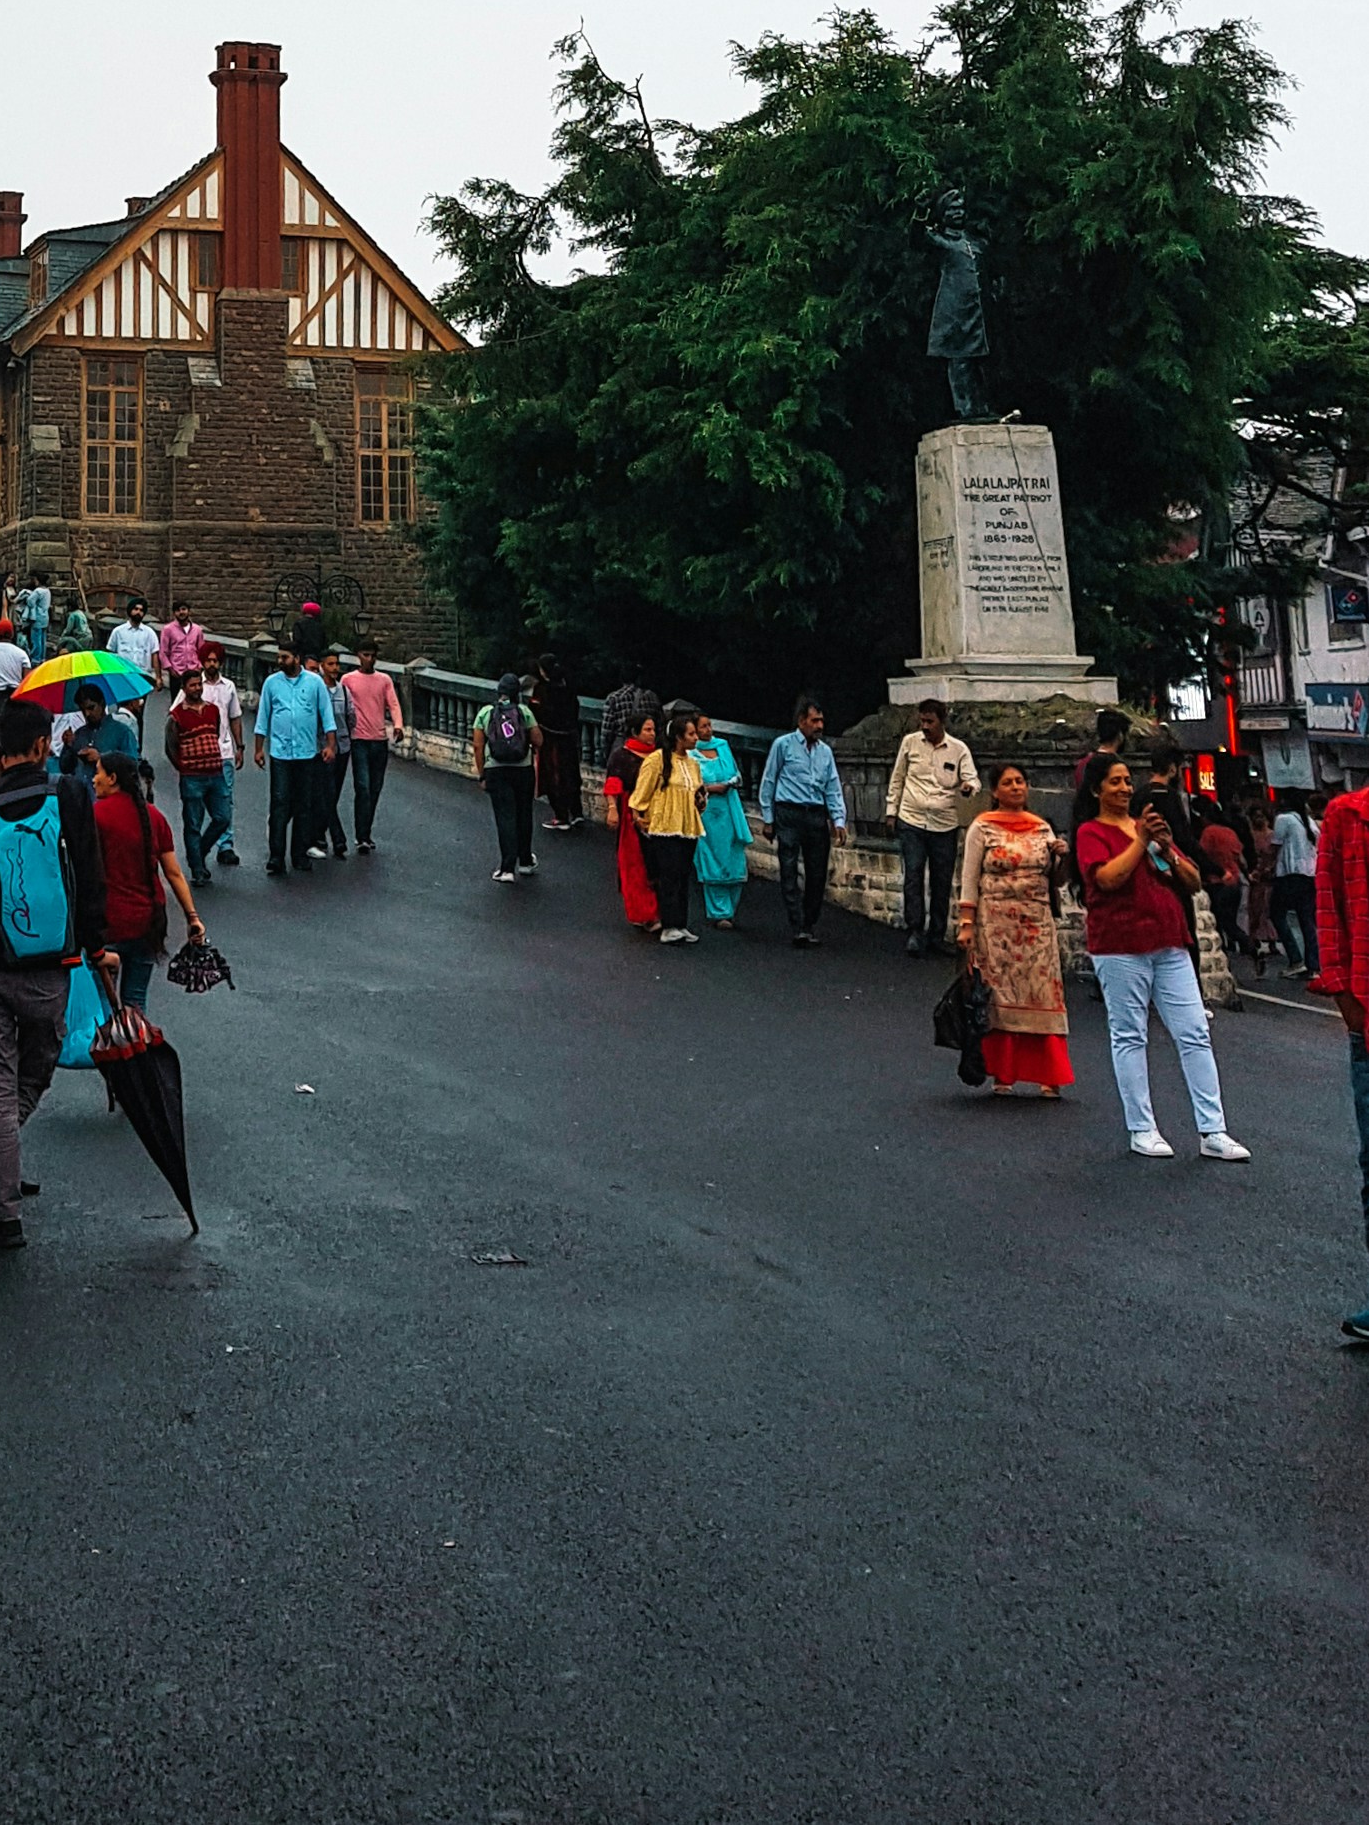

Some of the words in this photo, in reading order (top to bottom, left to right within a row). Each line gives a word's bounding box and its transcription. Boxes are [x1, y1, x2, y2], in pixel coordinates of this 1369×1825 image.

[963, 477, 989, 489] LALA
[990, 477, 1030, 490] LAJPAT
[1032, 477, 1050, 489] RAI
[963, 494, 980, 502] THE
[982, 494, 1011, 502] GREAT
[1013, 494, 1052, 503] PATRIOT
[999, 507, 1015, 516] OF
[985, 521, 1029, 529] PUNJAB
[1199, 771, 1215, 790] SALE
